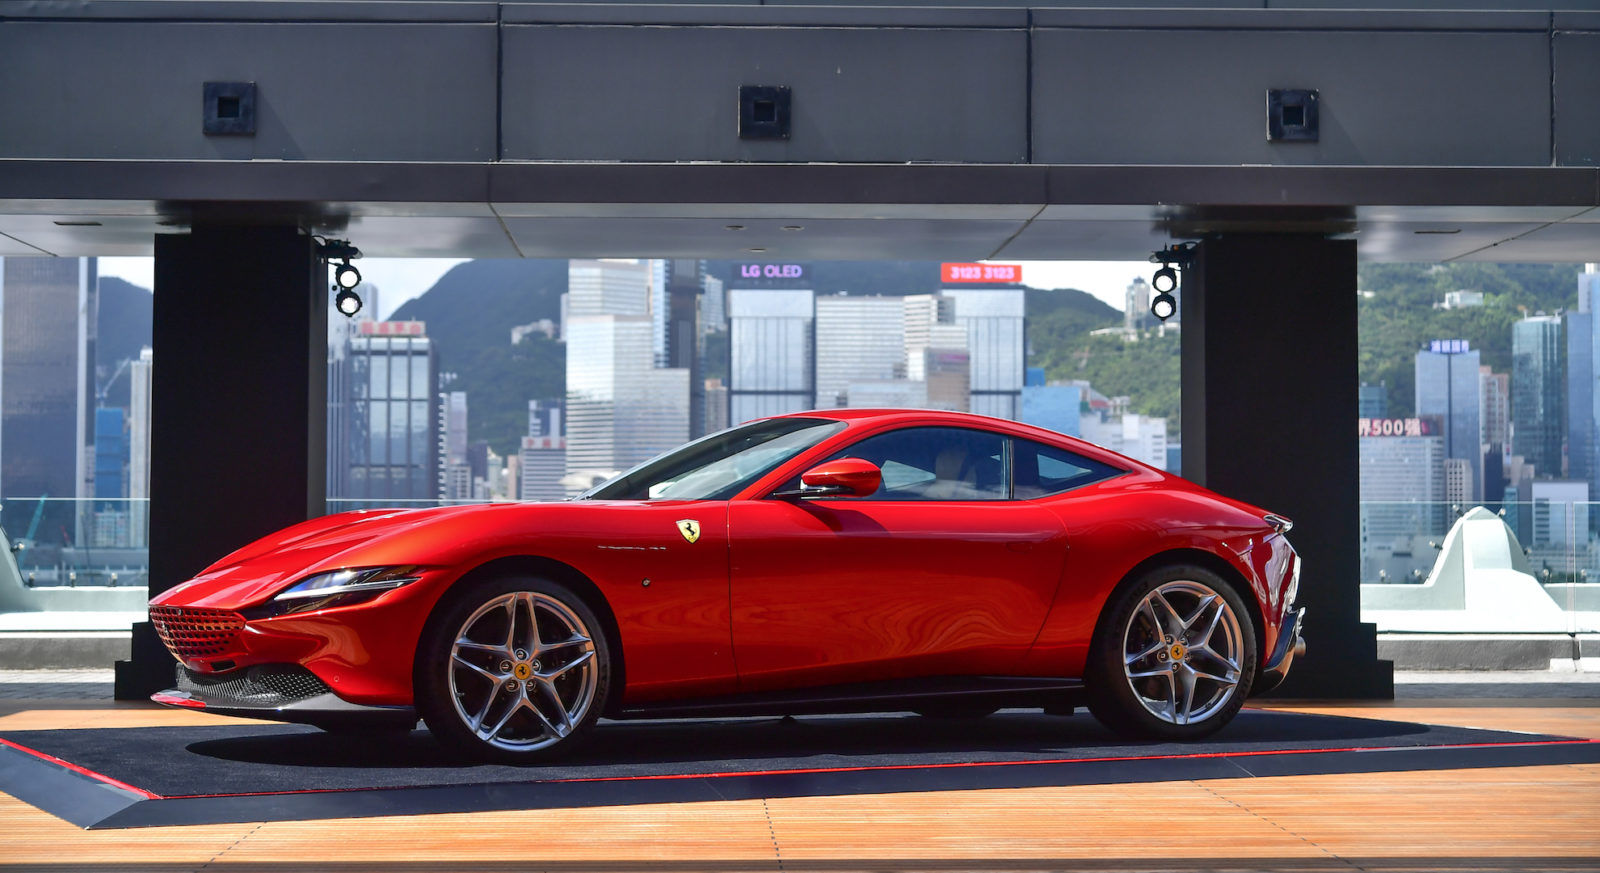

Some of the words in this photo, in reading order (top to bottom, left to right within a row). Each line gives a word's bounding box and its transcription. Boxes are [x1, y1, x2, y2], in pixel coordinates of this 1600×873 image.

[741, 265, 761, 278] LG
[764, 265, 802, 278] OLED
[950, 266, 981, 280] 3123
[984, 266, 1015, 280] 3123
